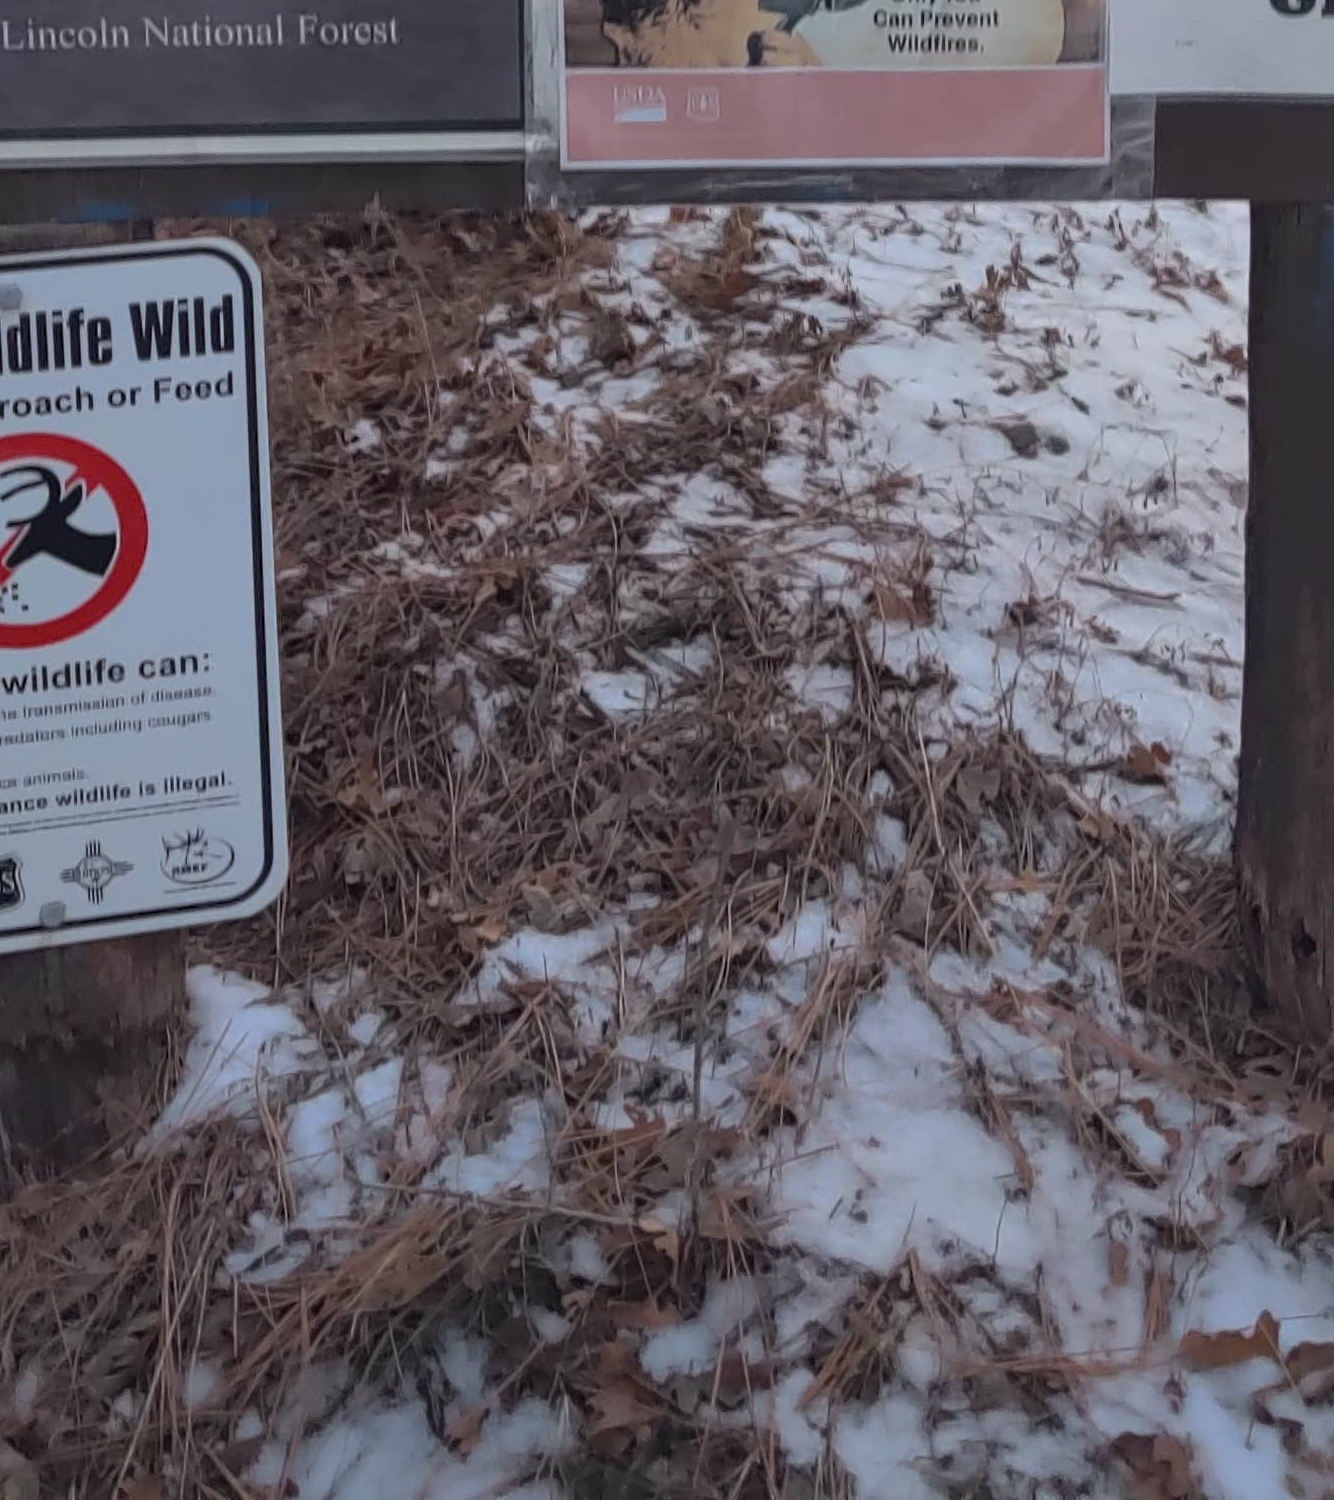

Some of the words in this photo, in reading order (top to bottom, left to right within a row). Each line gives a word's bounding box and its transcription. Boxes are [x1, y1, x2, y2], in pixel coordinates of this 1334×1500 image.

[2, 17, 130, 51] Lincoln
[142, 13, 284, 47] National
[297, 12, 402, 46] Forest
[873, 9, 913, 28] Can
[920, 7, 1000, 28] Prevent
[887, 32, 986, 54] Wildfires.
[128, 294, 235, 361] Wild
[107, 387, 143, 408] or
[153, 372, 235, 404] Feed
[0, 658, 126, 696] wildlife
[138, 651, 213, 680] can:
[22, 694, 126, 719] transmission
[131, 692, 146, 706] of
[70, 717, 143, 740] including
[147, 709, 212, 729] cougars
[54, 782, 131, 809] wildlife
[138, 779, 156, 797] is
[163, 768, 233, 794] illegal.
